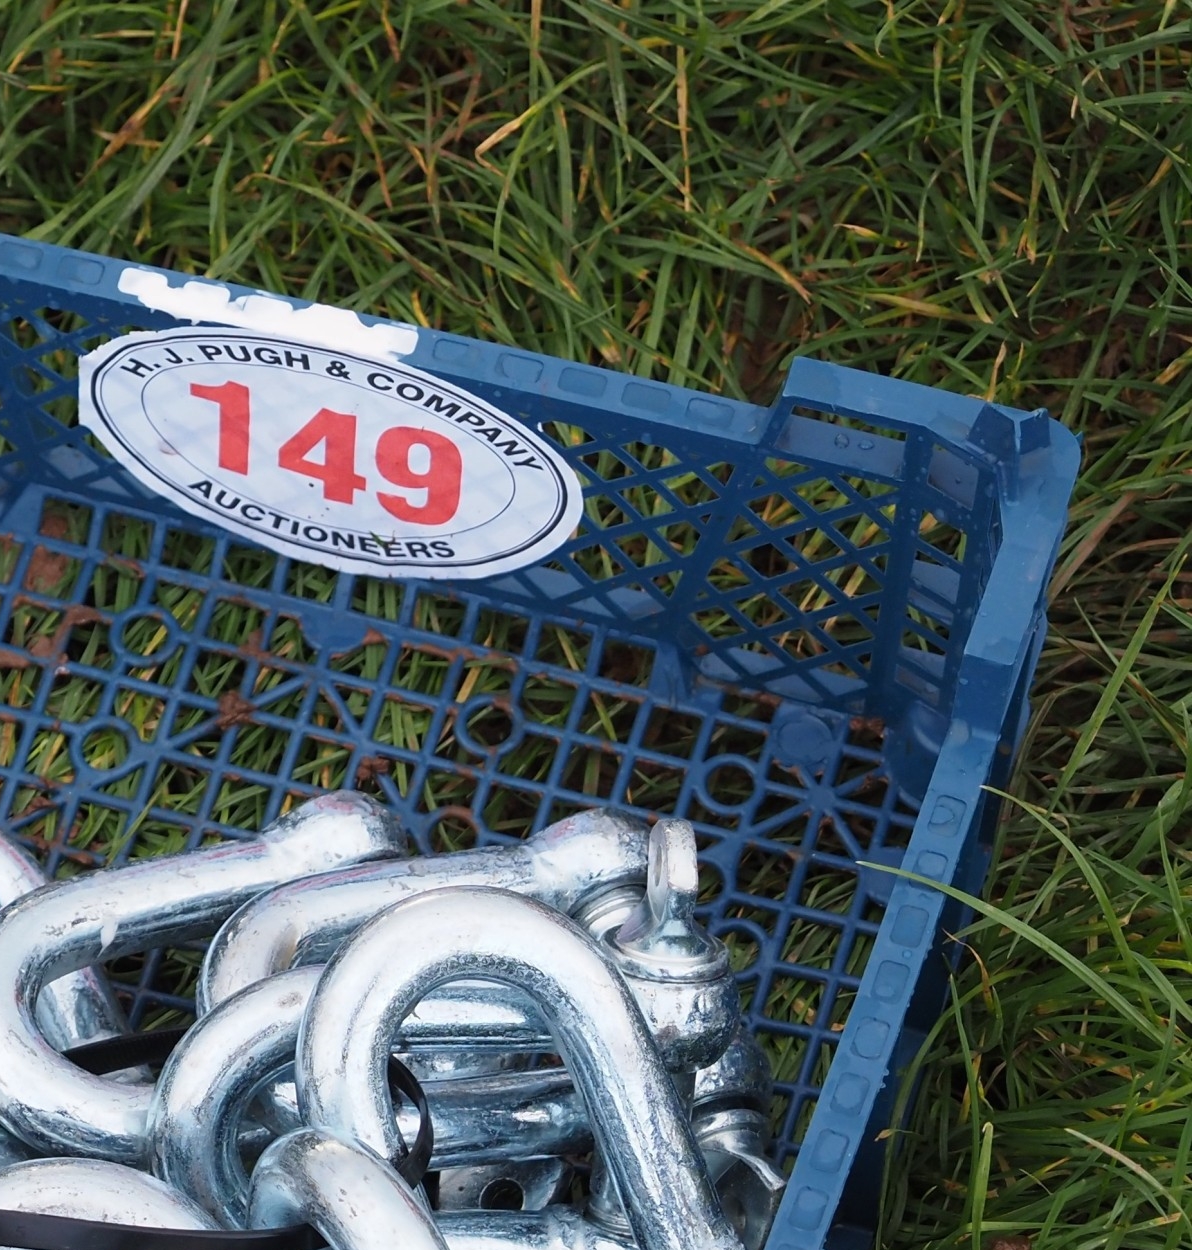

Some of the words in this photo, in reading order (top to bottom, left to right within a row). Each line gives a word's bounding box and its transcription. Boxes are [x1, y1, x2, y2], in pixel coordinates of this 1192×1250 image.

[190, 381, 463, 526] 149
[197, 344, 310, 371] PUGH
[325, 360, 351, 380] &
[366, 372, 544, 472] COMPANY
[188, 479, 455, 558] AUCTIONEERS
